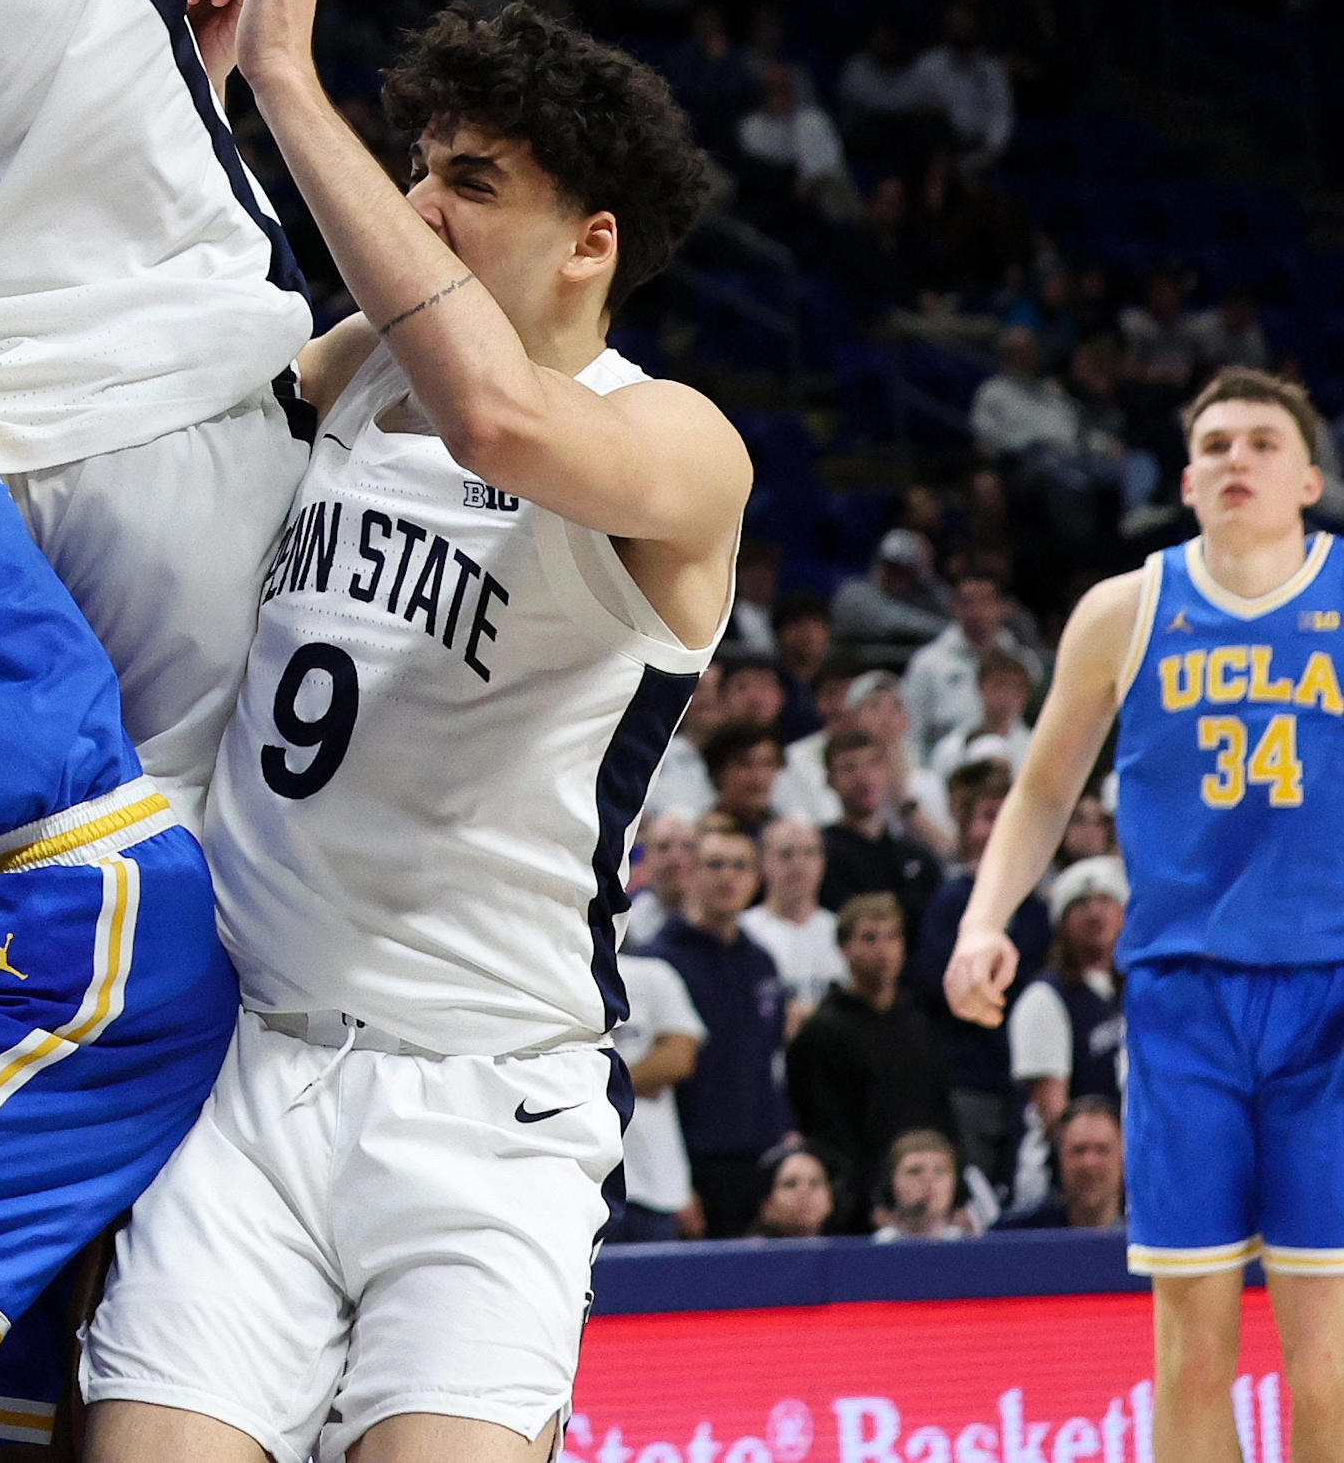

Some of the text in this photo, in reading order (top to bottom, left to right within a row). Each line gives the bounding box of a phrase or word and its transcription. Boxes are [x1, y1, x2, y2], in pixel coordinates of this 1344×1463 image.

[261, 501, 510, 683] ENN STATE
[261, 642, 359, 800] 9
[1158, 644, 1344, 717] UCLA
[1197, 715, 1304, 810] 34
